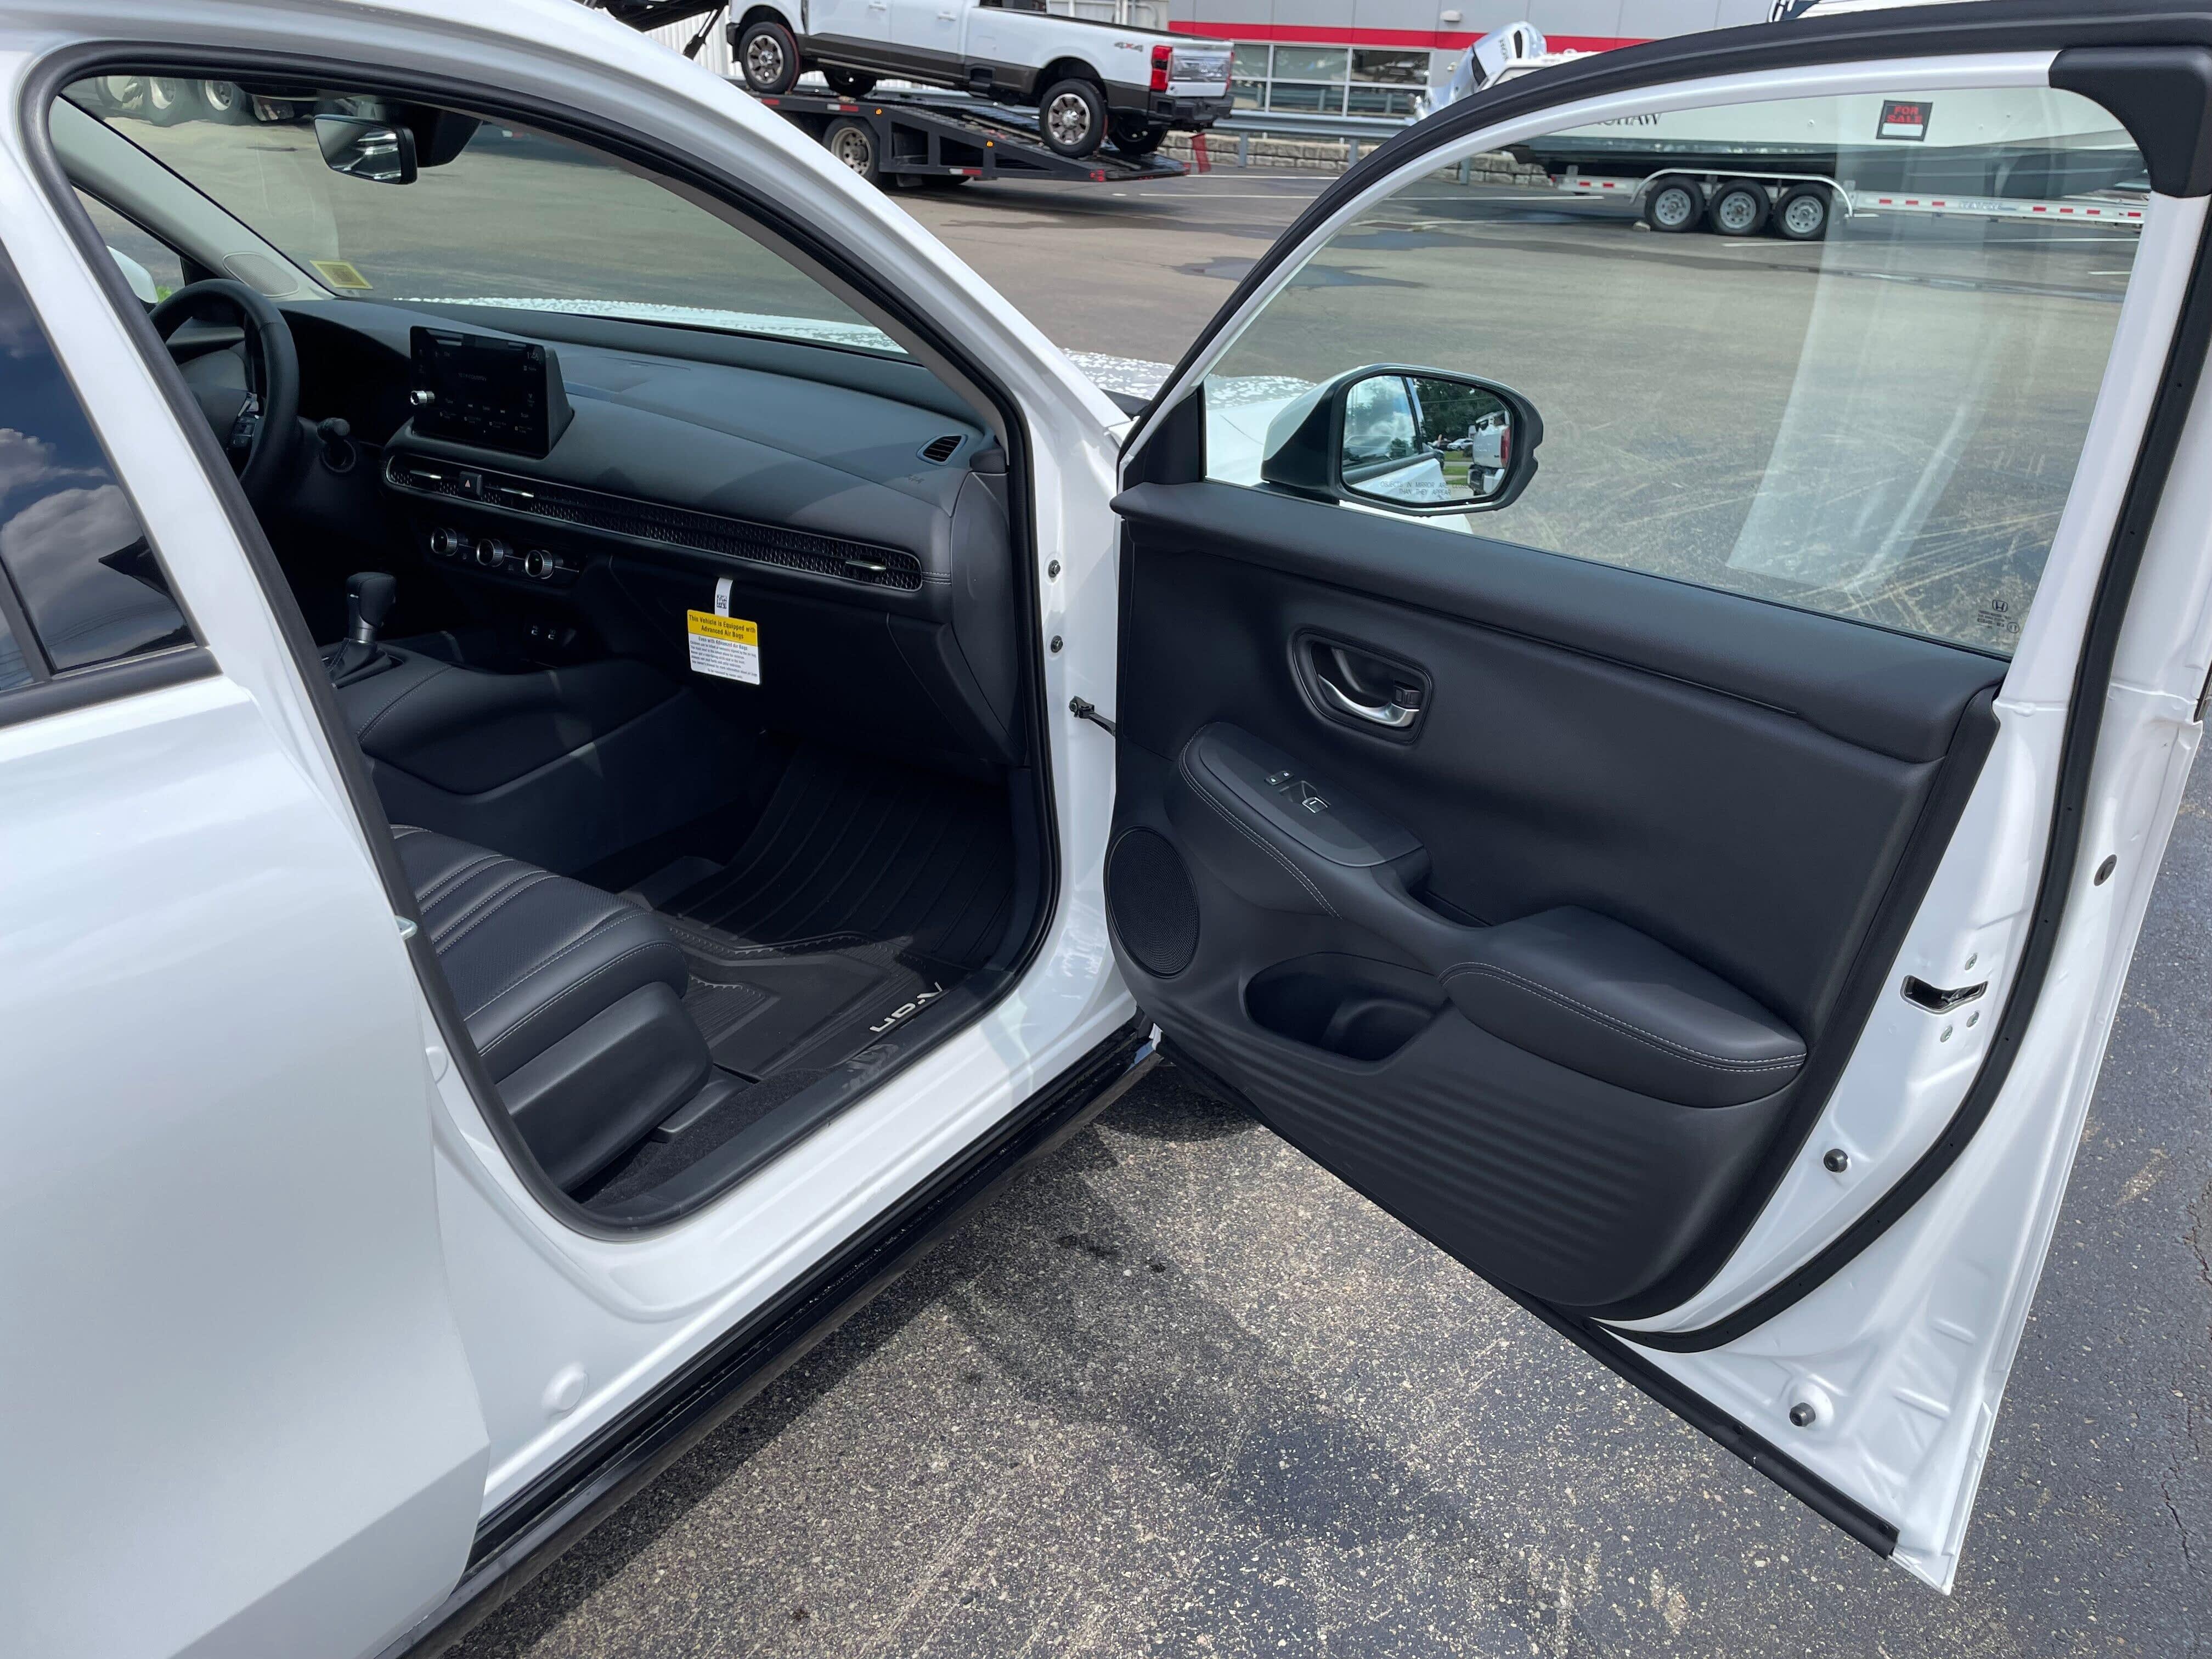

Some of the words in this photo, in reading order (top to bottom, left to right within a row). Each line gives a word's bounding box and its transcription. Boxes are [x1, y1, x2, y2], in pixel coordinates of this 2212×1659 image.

[1894, 105, 1918, 115] FOR
[1886, 115, 1922, 125] SALE
[699, 617, 716, 626] Vehicle
[723, 621, 744, 631] Equipped
[701, 625, 723, 635] Advanced
[732, 631, 744, 640] Bags
